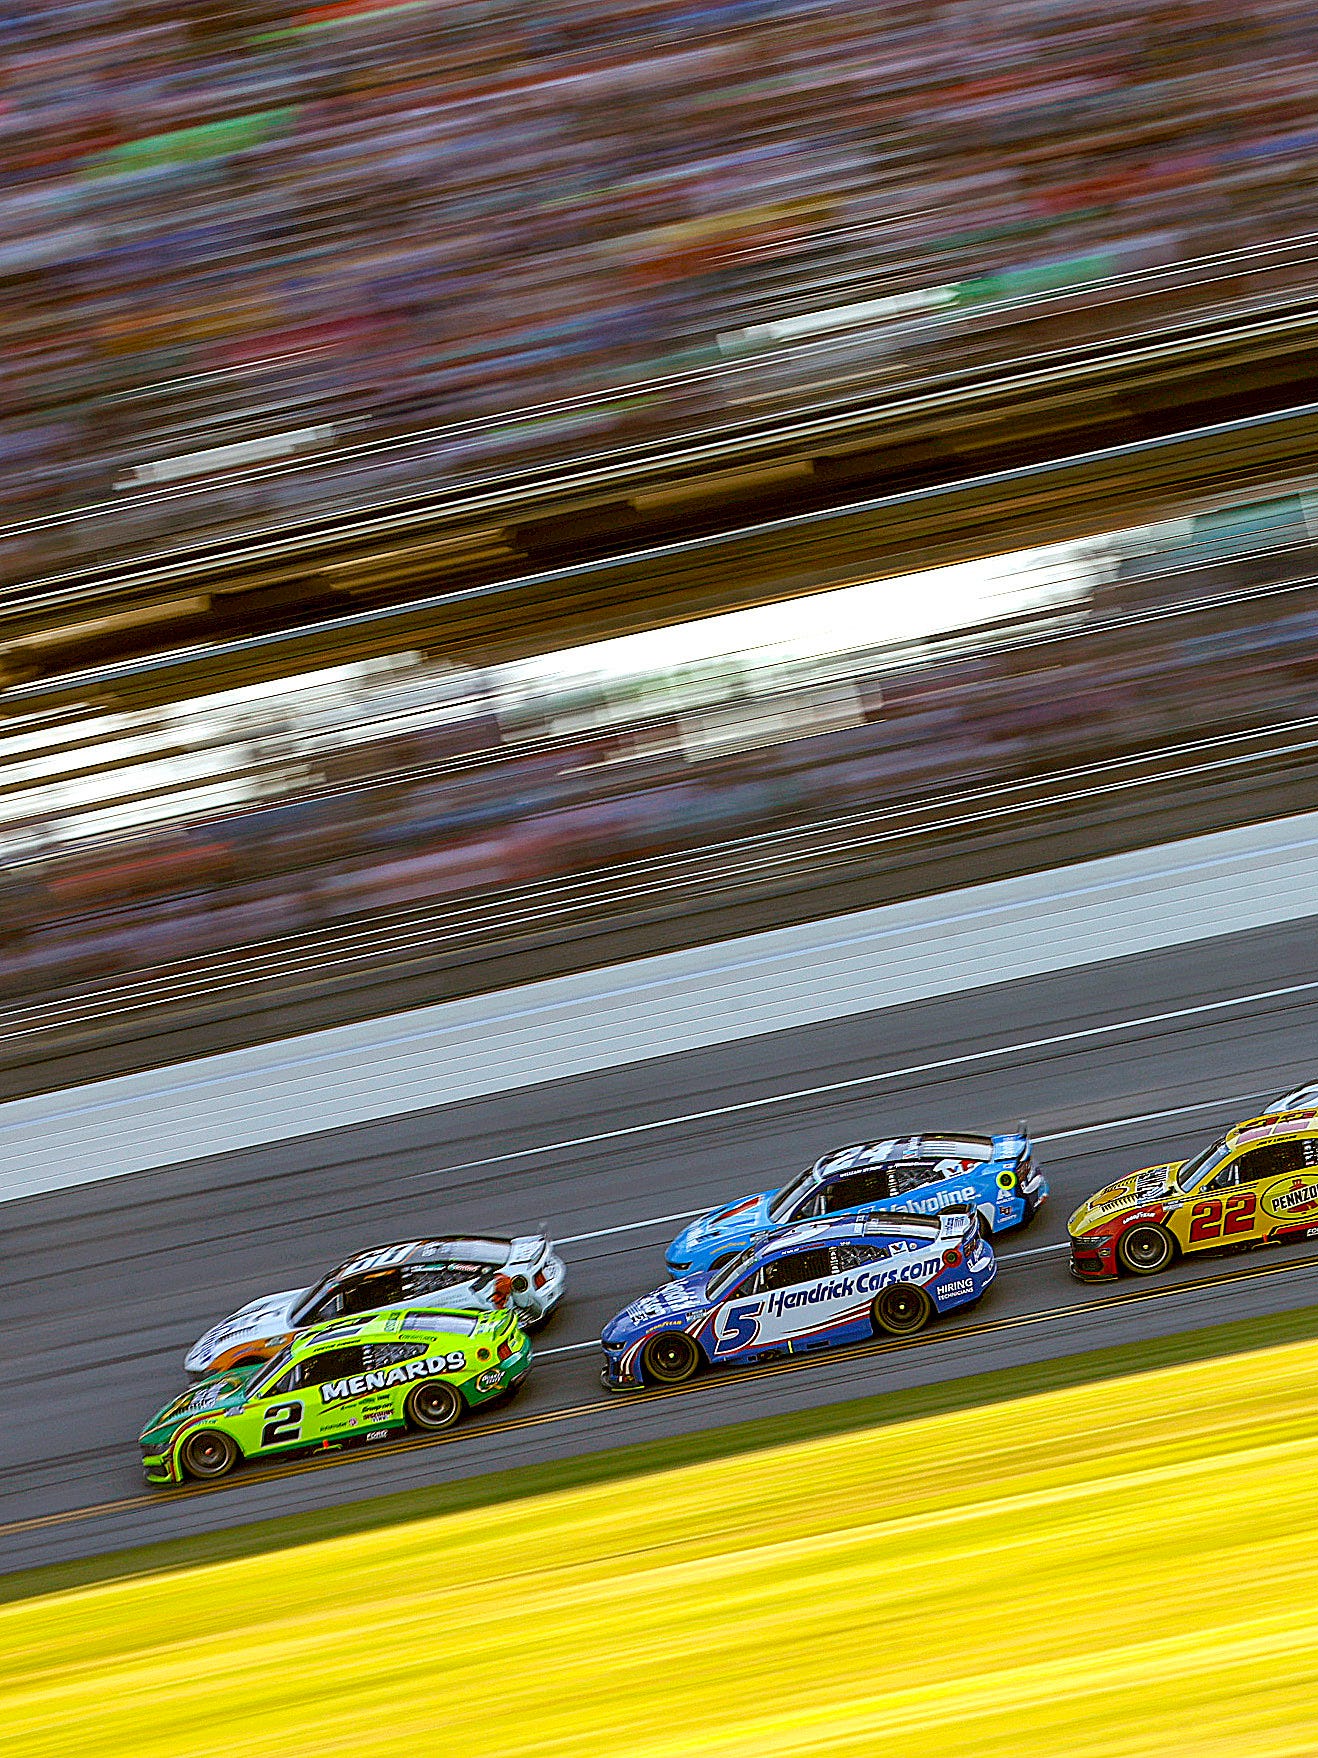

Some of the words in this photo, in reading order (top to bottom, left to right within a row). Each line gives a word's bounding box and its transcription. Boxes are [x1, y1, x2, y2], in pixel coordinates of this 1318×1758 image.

[825, 1138, 900, 1177] 24
[1189, 1192, 1256, 1243] 22
[936, 1277, 974, 1295] HIRING
[938, 1287, 974, 1301] TECHNICIANS
[715, 1300, 764, 1355] 5
[320, 1351, 466, 1403] MENARDS
[260, 1400, 304, 1447] 2
